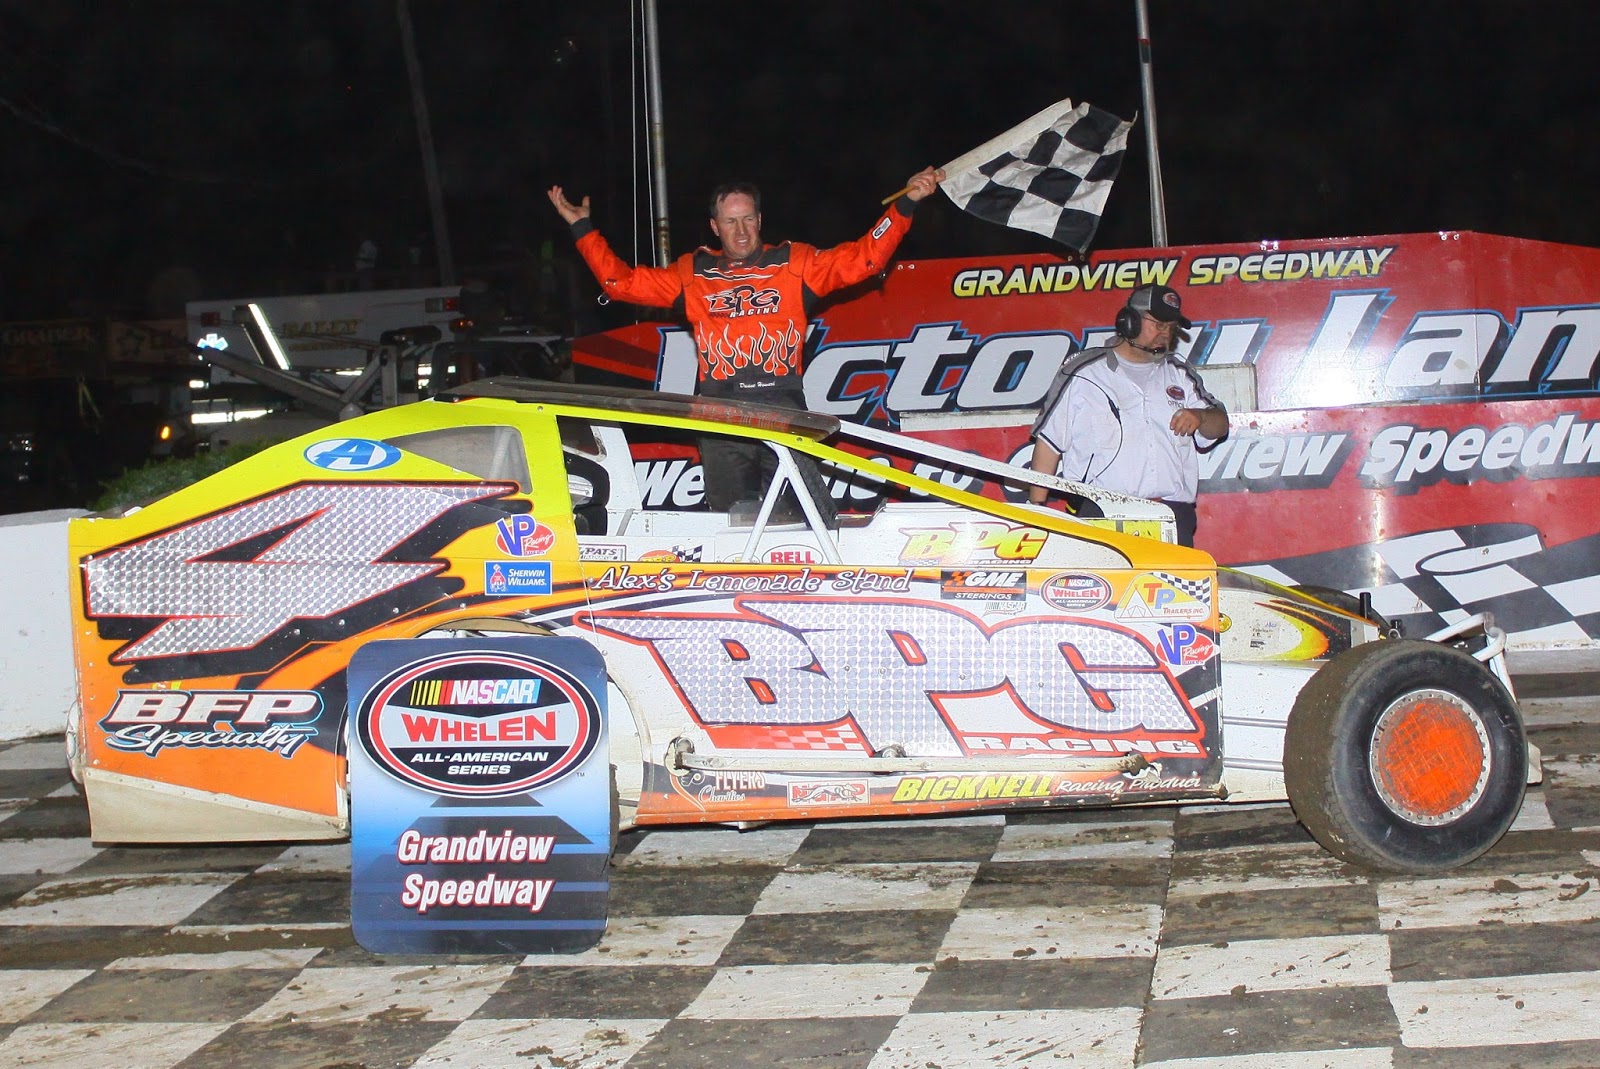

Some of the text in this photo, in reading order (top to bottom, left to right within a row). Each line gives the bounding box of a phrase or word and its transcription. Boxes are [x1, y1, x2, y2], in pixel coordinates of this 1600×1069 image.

[952, 246, 1394, 298] GRANDVIEW SPEEDWAY
[703, 284, 781, 312] BPG
[729, 305, 779, 318] RACING
[496, 514, 536, 557] VP
[899, 522, 1049, 562] BPG
[770, 551, 815, 564] BELL
[508, 568, 545, 578] SHERWIN
[591, 565, 917, 593] Alex's Lemonade Stand
[965, 571, 1024, 588] GME
[1068, 579, 1094, 587] NASCAR
[954, 592, 1013, 600] STEERINGS
[1052, 589, 1100, 598] WHELEN
[1162, 607, 1191, 615] TRAILERS
[1157, 624, 1196, 666] VP
[592, 598, 1200, 758] BPG
[448, 679, 537, 705] NASCAR
[106, 691, 319, 724] BFP
[105, 722, 317, 757] Specialty
[400, 711, 557, 742] WHELEN
[410, 751, 549, 763] ALL-AMERICAN
[961, 736, 1200, 754] RACING
[447, 764, 511, 775] SERIES
[715, 770, 766, 790] FLYERS
[892, 774, 1054, 802] BICKNELL
[1055, 779, 1125, 796] Racing
[398, 829, 554, 864] Grandview
[401, 872, 554, 913] Speedway
